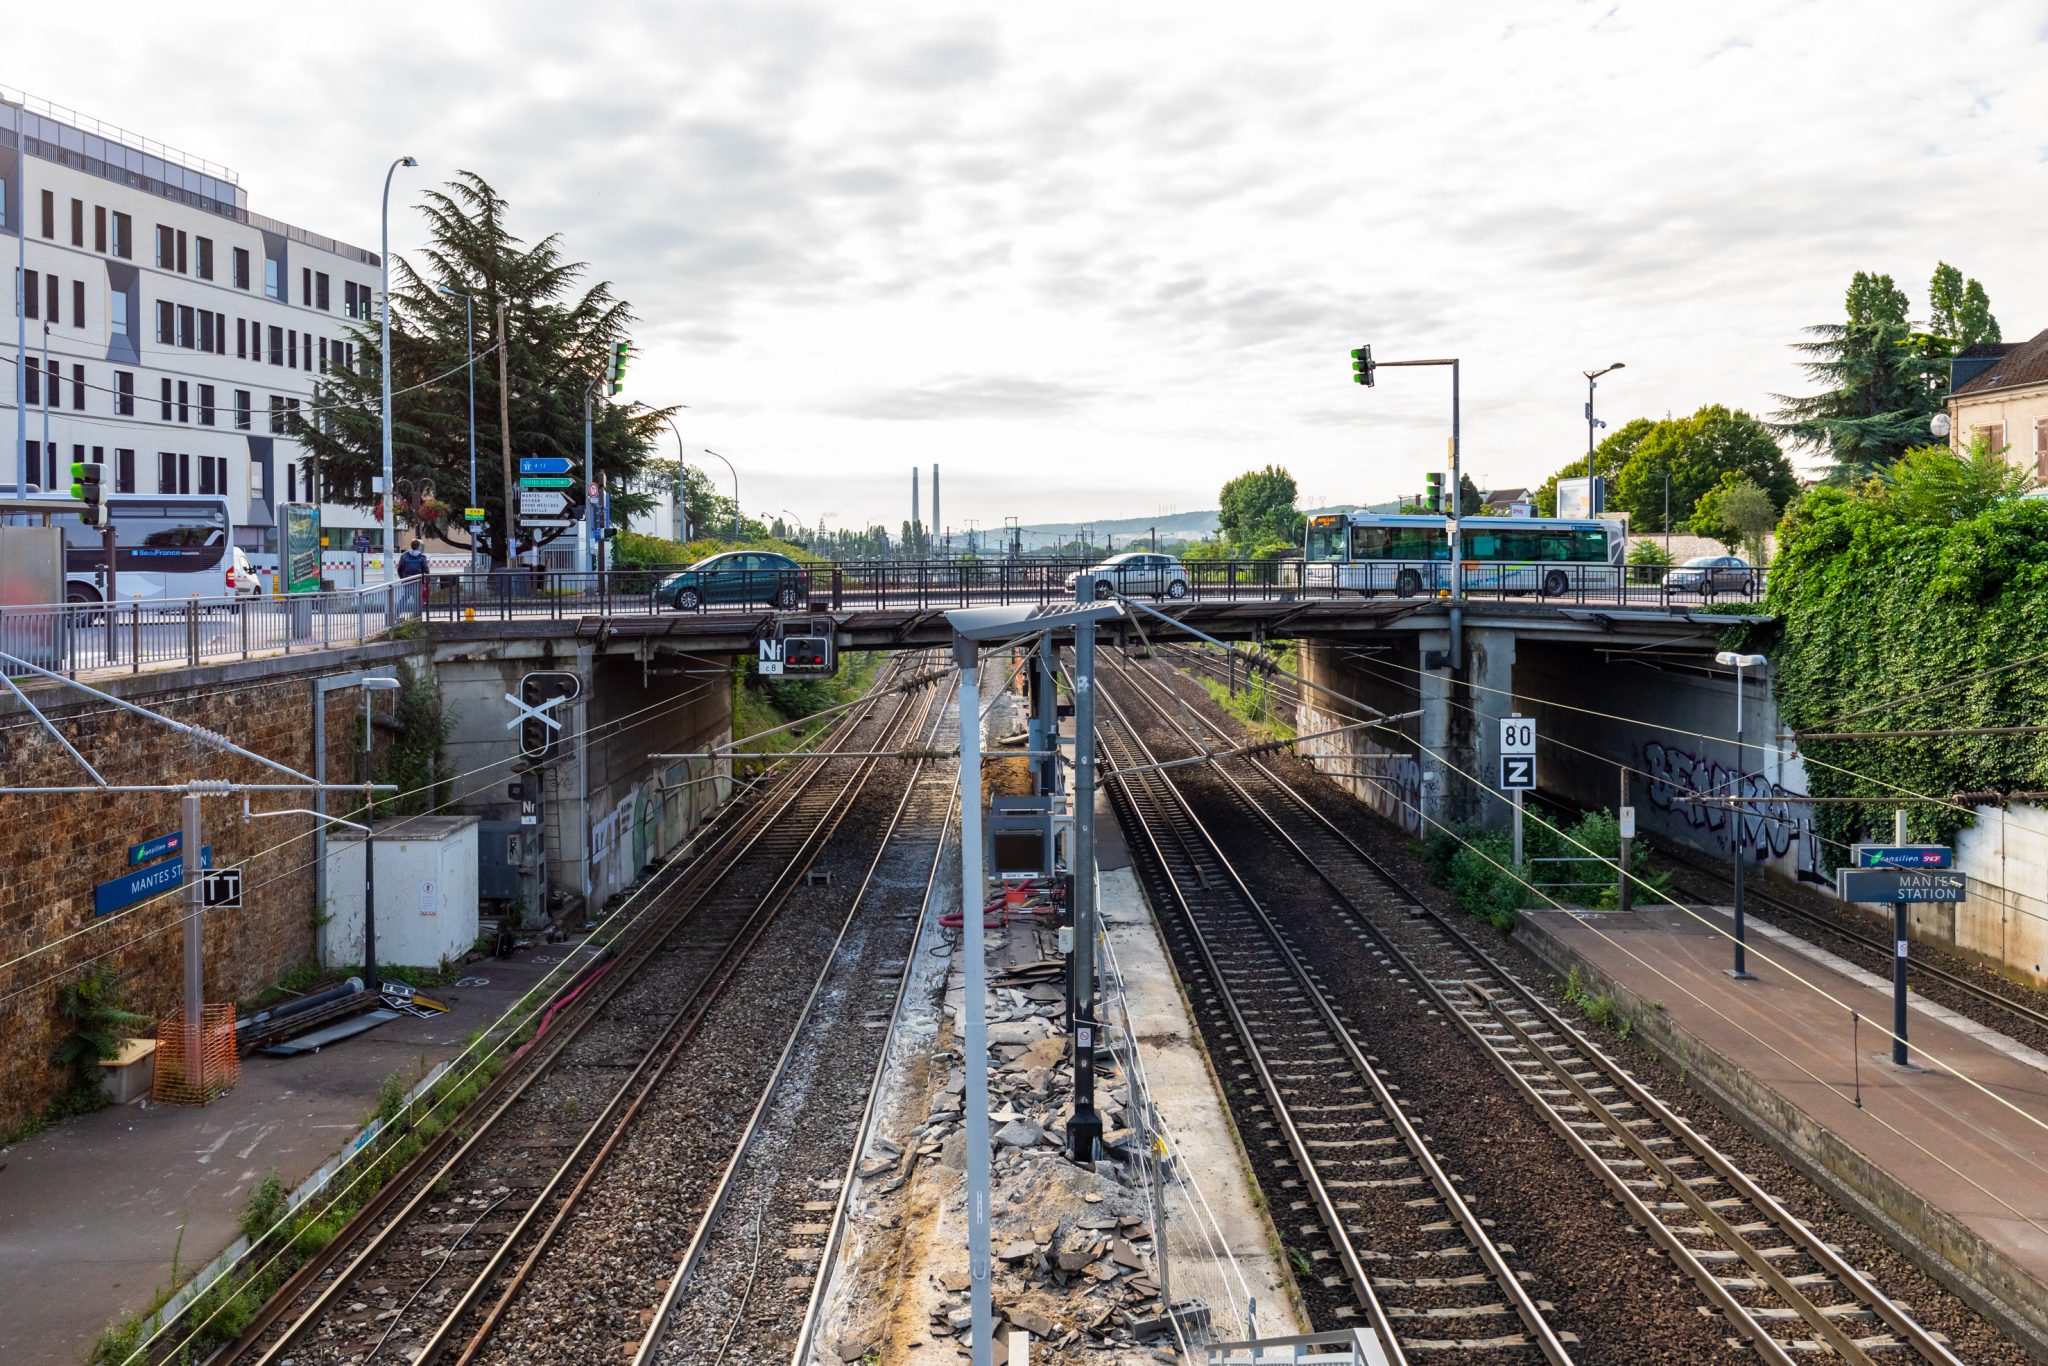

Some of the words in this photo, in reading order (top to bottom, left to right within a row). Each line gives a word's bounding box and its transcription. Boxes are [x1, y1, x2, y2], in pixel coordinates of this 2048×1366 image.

[759, 639, 783, 660] Nf
[1506, 726, 1531, 746] 80
[1508, 761, 1528, 783] Z
[522, 800, 536, 813] Nf
[167, 839, 178, 847] SNCF
[1923, 855, 1941, 863] SNCF
[131, 869, 169, 894] MANTES
[204, 876, 239, 901] TT
[1898, 888, 1956, 899] STATION
